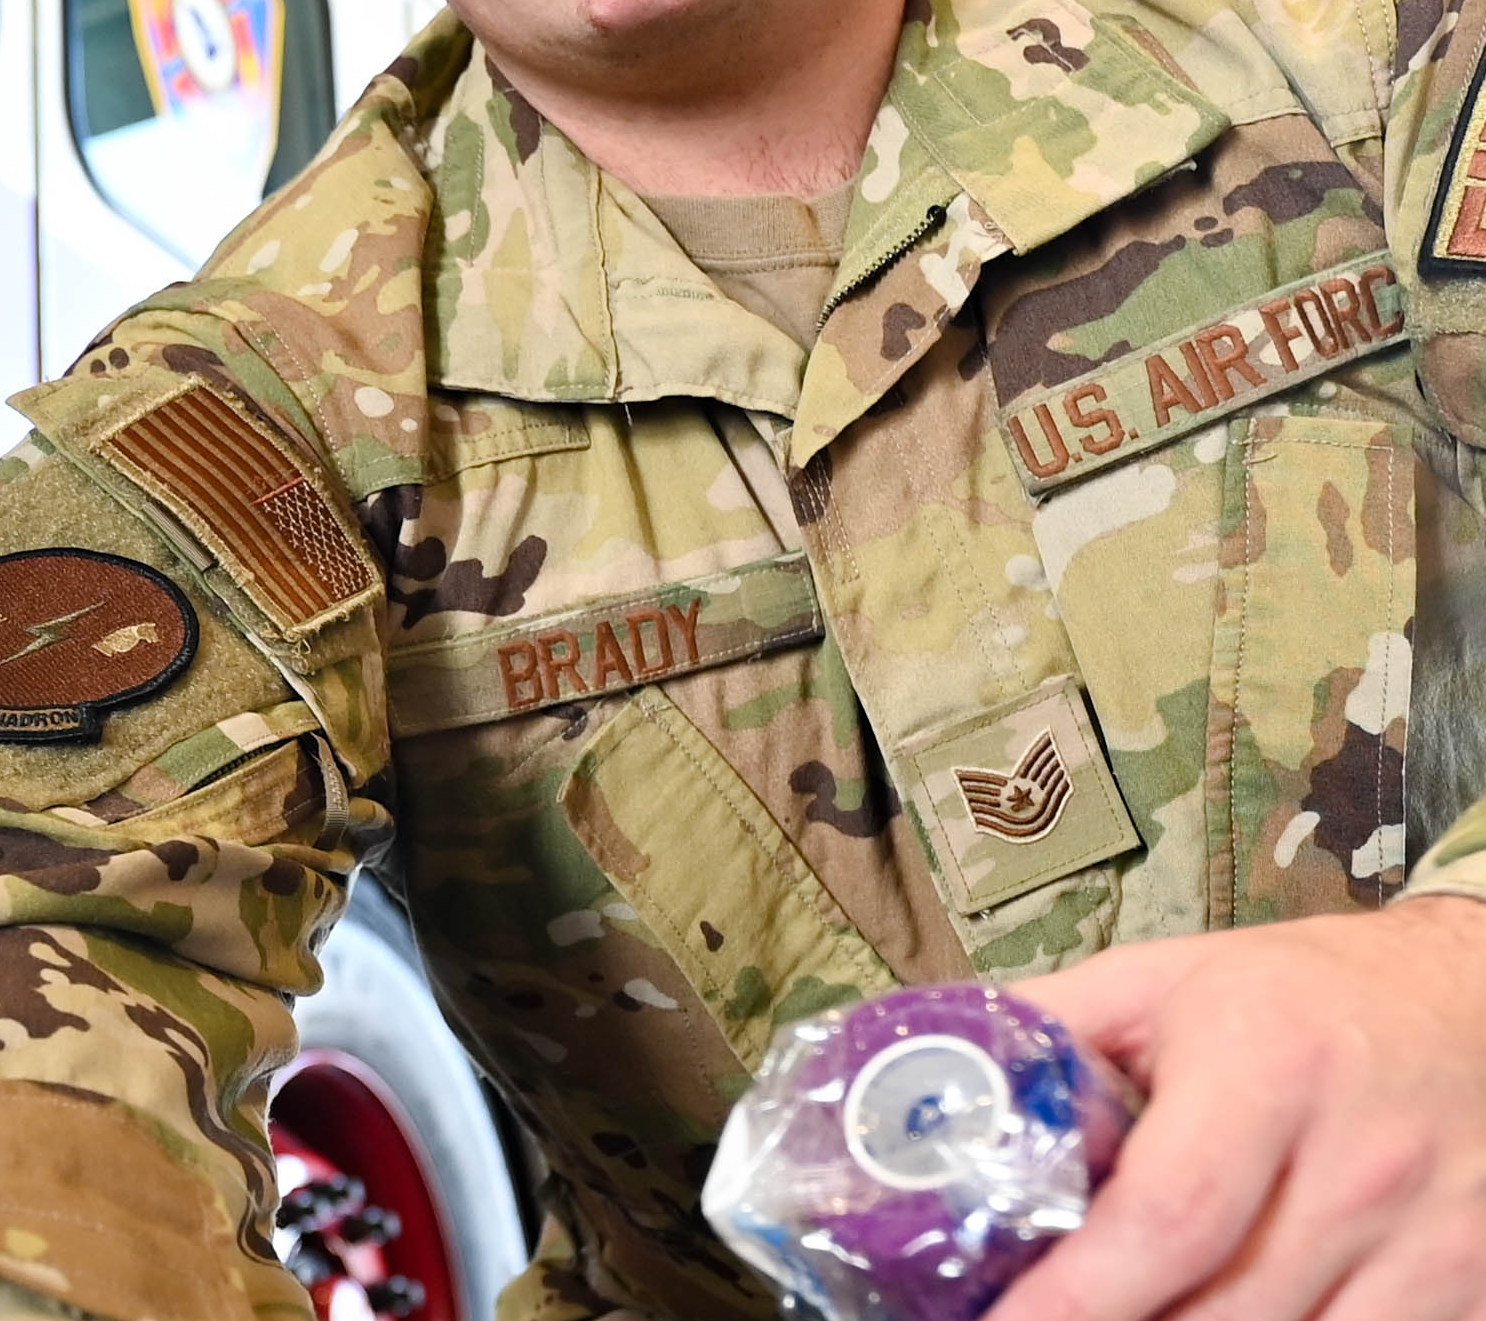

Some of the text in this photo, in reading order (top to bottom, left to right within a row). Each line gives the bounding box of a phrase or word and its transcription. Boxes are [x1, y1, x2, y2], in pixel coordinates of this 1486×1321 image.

[1007, 265, 1406, 479] U.S. AIR FORC
[497, 596, 702, 712] BRADY
